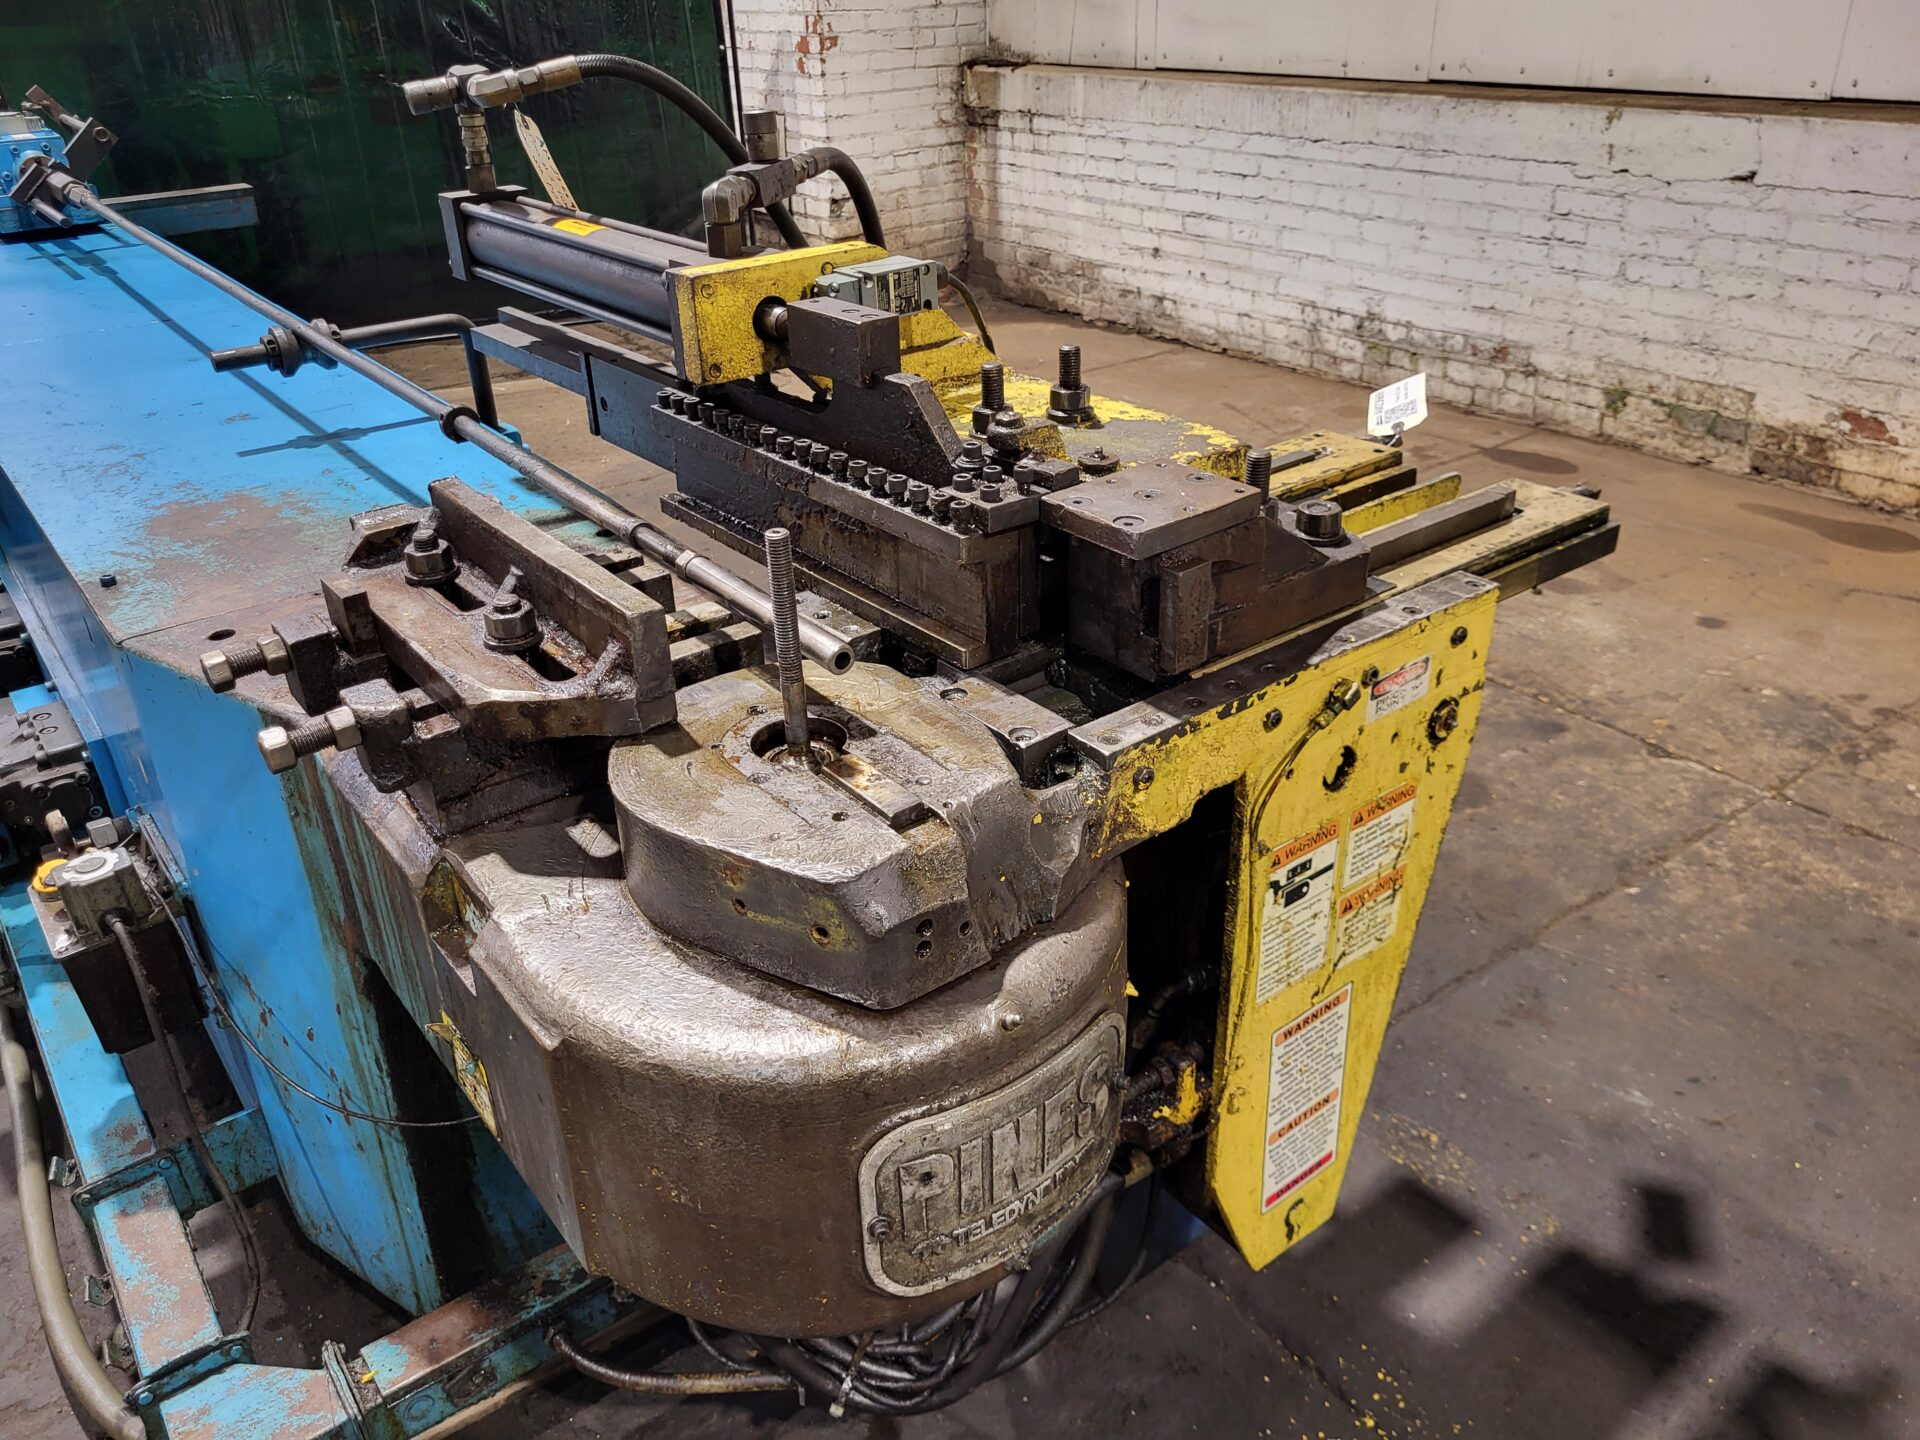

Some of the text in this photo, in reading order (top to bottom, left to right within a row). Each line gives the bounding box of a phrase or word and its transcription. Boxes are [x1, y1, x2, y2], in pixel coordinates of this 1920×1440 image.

[1284, 824, 1337, 860] WARNING
[1283, 995, 1341, 1040] WARNING
[1278, 1095, 1330, 1138] CAUTION
[899, 1052, 1110, 1242] PINES
